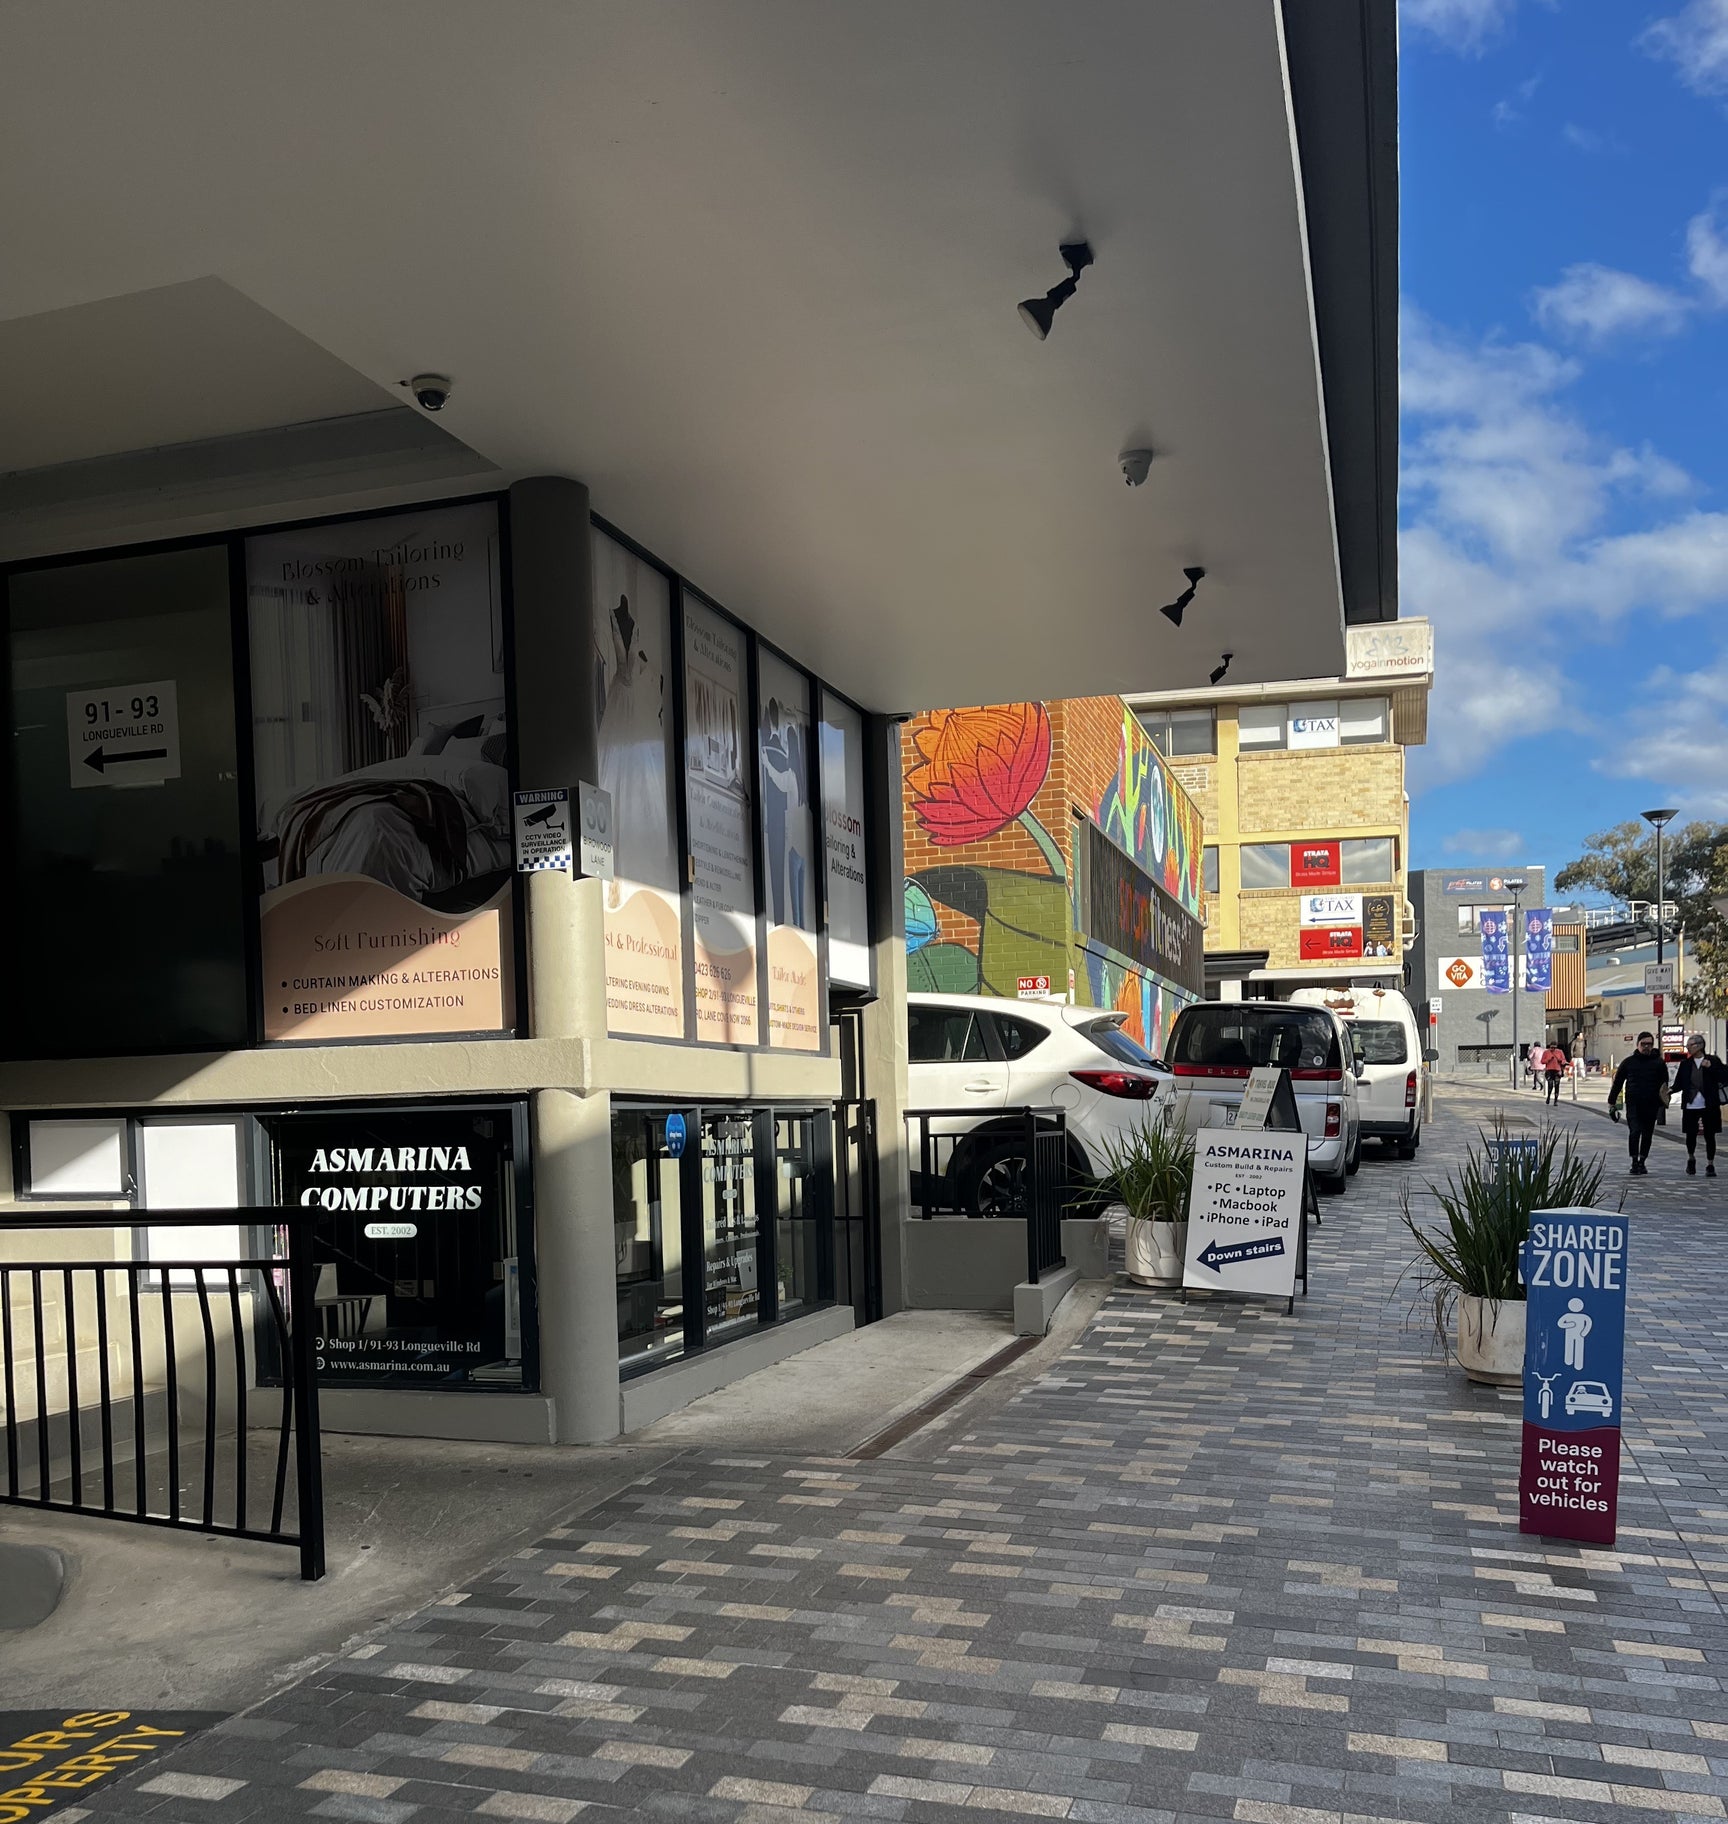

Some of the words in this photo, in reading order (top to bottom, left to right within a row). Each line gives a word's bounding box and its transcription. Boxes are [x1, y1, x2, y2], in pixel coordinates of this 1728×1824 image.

[282, 557, 365, 581] Blossom
[371, 540, 464, 568] Tailoring
[307, 587, 321, 605] &
[82, 725, 148, 741] LONGUEVILLE
[150, 723, 164, 734] RD
[1307, 719, 1335, 731] TAX
[519, 791, 564, 803] WARNING
[586, 798, 606, 834] 30
[521, 838, 567, 848] SURVEILLANCE
[525, 833, 541, 841] CCTV
[583, 835, 612, 854] BIRDWOOD
[530, 846, 565, 854] OPERATION
[826, 834, 850, 860] ailoring
[851, 843, 857, 859] &
[590, 854, 605, 866] LANE
[1304, 855, 1330, 869] HQ
[831, 857, 865, 884] Alterations
[1325, 900, 1354, 912] TAX
[1150, 886, 1182, 967] fitness
[314, 932, 351, 951] Soft
[358, 928, 461, 948] Furnishing
[616, 933, 624, 950] &
[626, 934, 677, 960] Professional
[1330, 936, 1353, 948] HQ
[1450, 972, 1469, 981] VITA
[1451, 964, 1467, 973] GO
[293, 976, 346, 989] CURTAIN
[349, 972, 398, 987] MAKING
[401, 972, 409, 984] &
[413, 967, 499, 983] ALTERATIONS
[606, 976, 628, 989] LTERING
[629, 979, 650, 993] EVENING
[1019, 979, 1033, 989] NO
[294, 1003, 317, 1014] BED
[320, 1000, 356, 1012] LINEN
[360, 995, 464, 1011] CUSTOMIZATION
[607, 998, 628, 1010] EDDING
[629, 1000, 645, 1013] DRESS
[646, 1003, 679, 1017] ALTERATIONS
[704, 1010, 716, 1022] LANE
[1208, 1068, 1251, 1076] ELGR
[705, 1138, 752, 1156] ASMARINA
[1206, 1145, 1294, 1161] ASMARINA
[308, 1146, 472, 1172] ASMARINA
[1204, 1161, 1233, 1169] Custom
[1264, 1165, 1293, 1173] Repairs
[703, 1163, 754, 1184] COMPUTERS
[300, 1186, 482, 1211] COMPUTERS
[1215, 1182, 1231, 1194] PC
[1243, 1184, 1286, 1199] Laptop
[1219, 1198, 1277, 1212] Macbook
[1207, 1212, 1250, 1226] iPhone
[1262, 1216, 1289, 1229] iPad
[371, 1226, 389, 1235] EST.
[391, 1226, 411, 1235] 2002
[1532, 1223, 1623, 1251] SHARED
[1207, 1249, 1242, 1262] Down
[1245, 1243, 1282, 1256] stairs
[706, 1258, 726, 1274] Repairs
[726, 1257, 731, 1268] &
[1532, 1249, 1621, 1290] ZONE
[707, 1303, 718, 1315] Shop
[329, 1338, 355, 1352] Shop
[401, 1340, 464, 1352] Longueville
[466, 1341, 480, 1352] Rd
[330, 1360, 450, 1372] www.asmarina.com.au
[1539, 1438, 1603, 1458] Please
[1540, 1459, 1599, 1475] watch
[1537, 1476, 1569, 1490] out
[1574, 1477, 1602, 1493] for
[1529, 1491, 1608, 1512] vehicles
